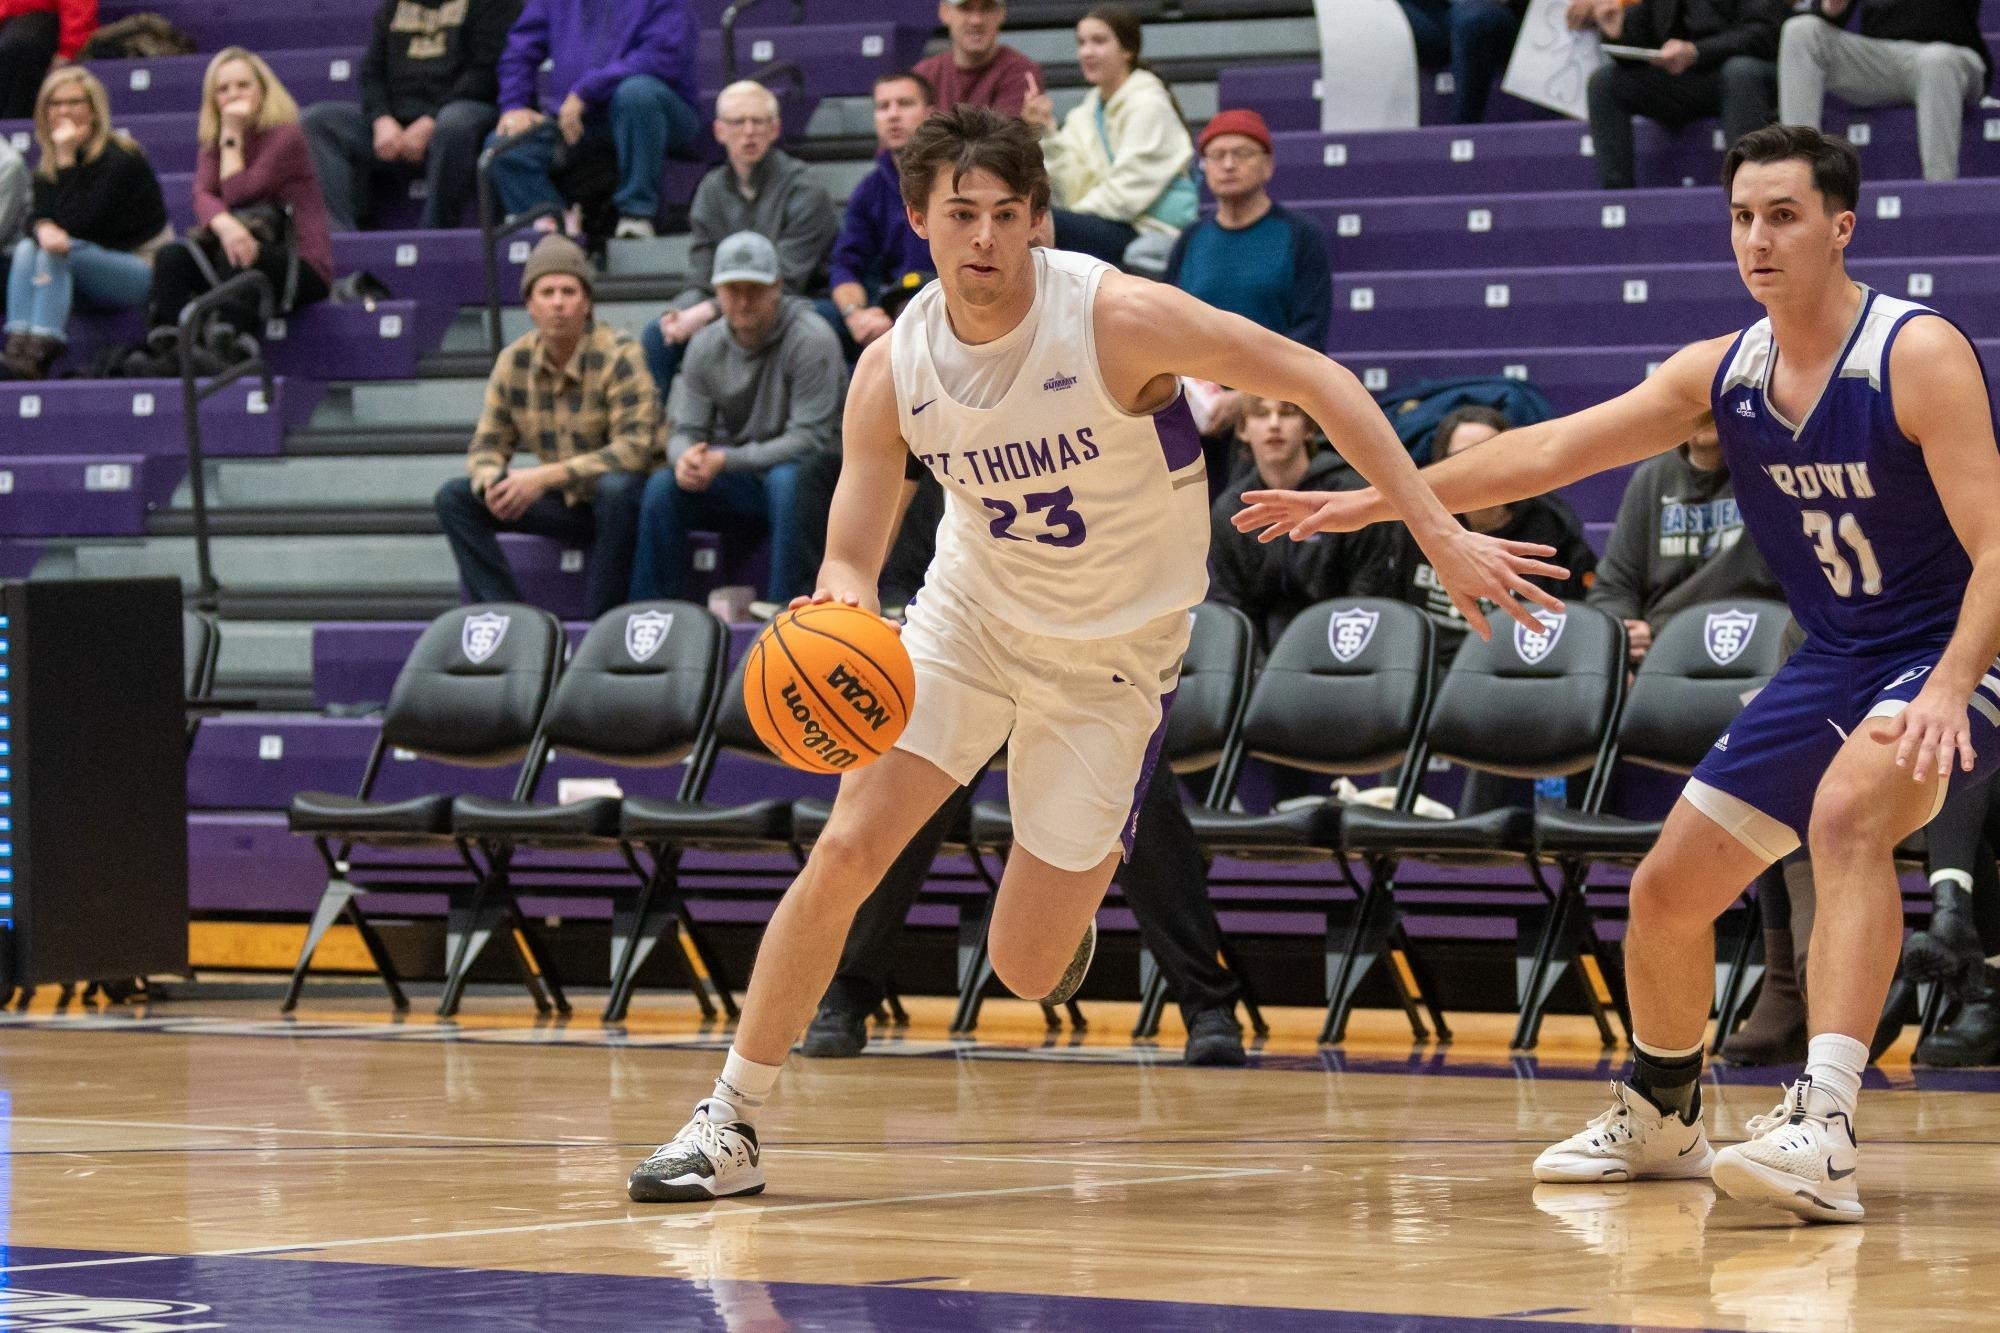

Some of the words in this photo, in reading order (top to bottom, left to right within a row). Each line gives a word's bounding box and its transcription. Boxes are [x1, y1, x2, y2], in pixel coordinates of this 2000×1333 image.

[1043, 375, 1078, 391] SUMMIT
[963, 427, 1100, 485] THOMAS
[1760, 461, 1877, 500] ROWN
[981, 486, 1087, 548] 23
[1801, 509, 1883, 598] 31
[781, 681, 859, 769] Wilson
[826, 663, 891, 732] NCAA
